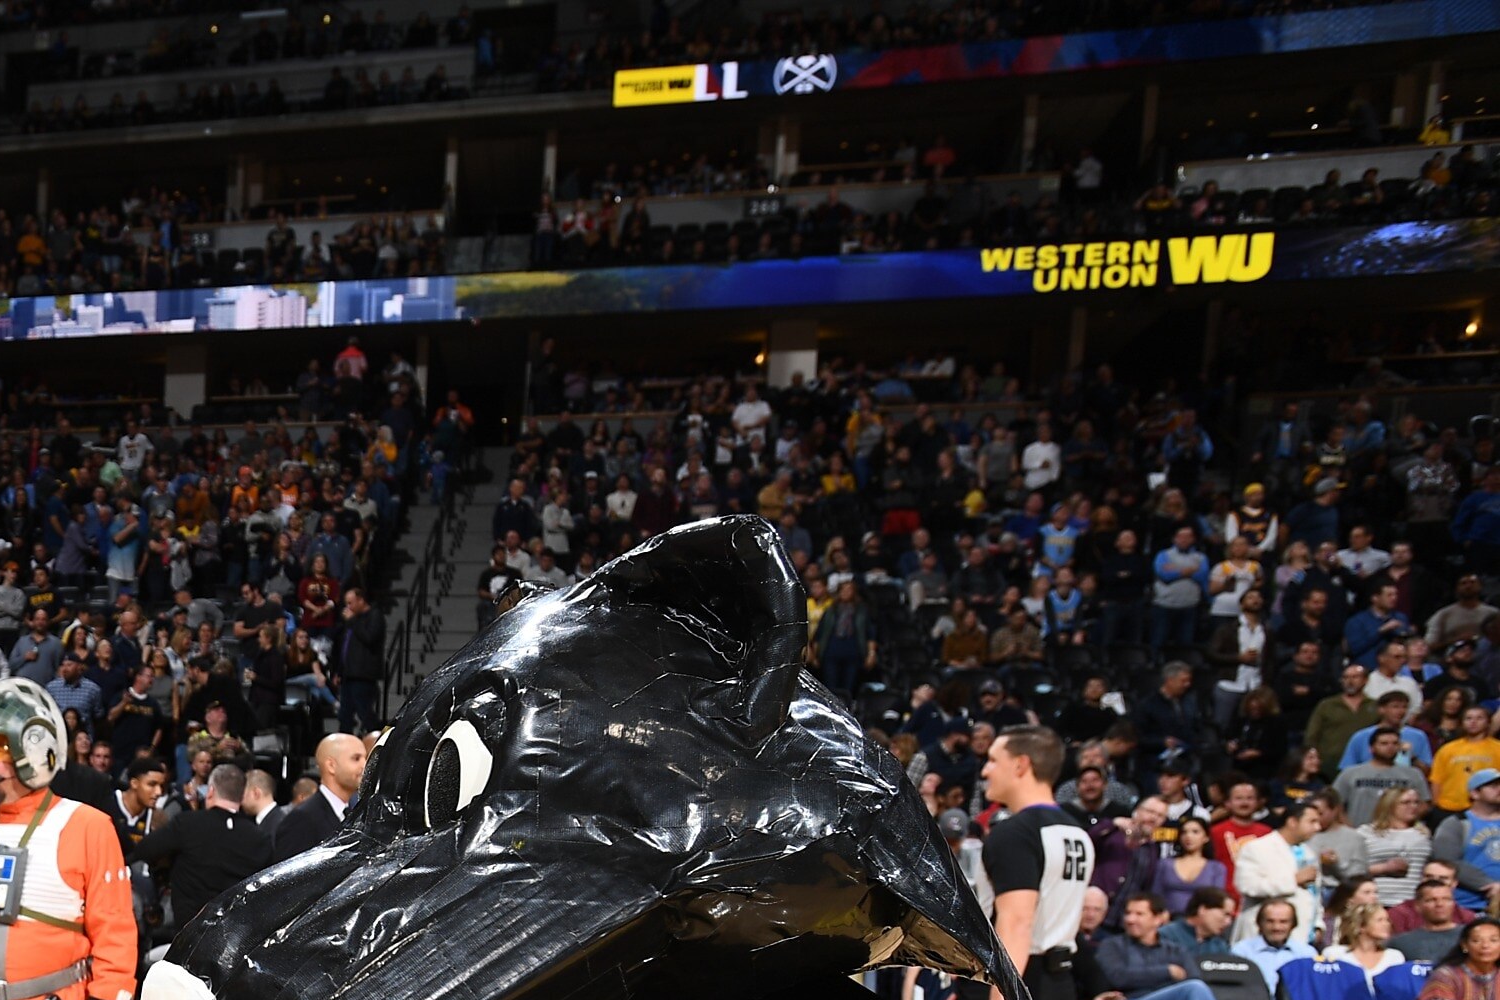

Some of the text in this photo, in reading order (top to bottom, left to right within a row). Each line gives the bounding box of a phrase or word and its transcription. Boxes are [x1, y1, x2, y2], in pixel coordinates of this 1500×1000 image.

[980, 239, 1160, 273] WESTERN
[1167, 232, 1275, 285] WU
[1032, 264, 1158, 293] UNION
[1063, 838, 1086, 881] 62
